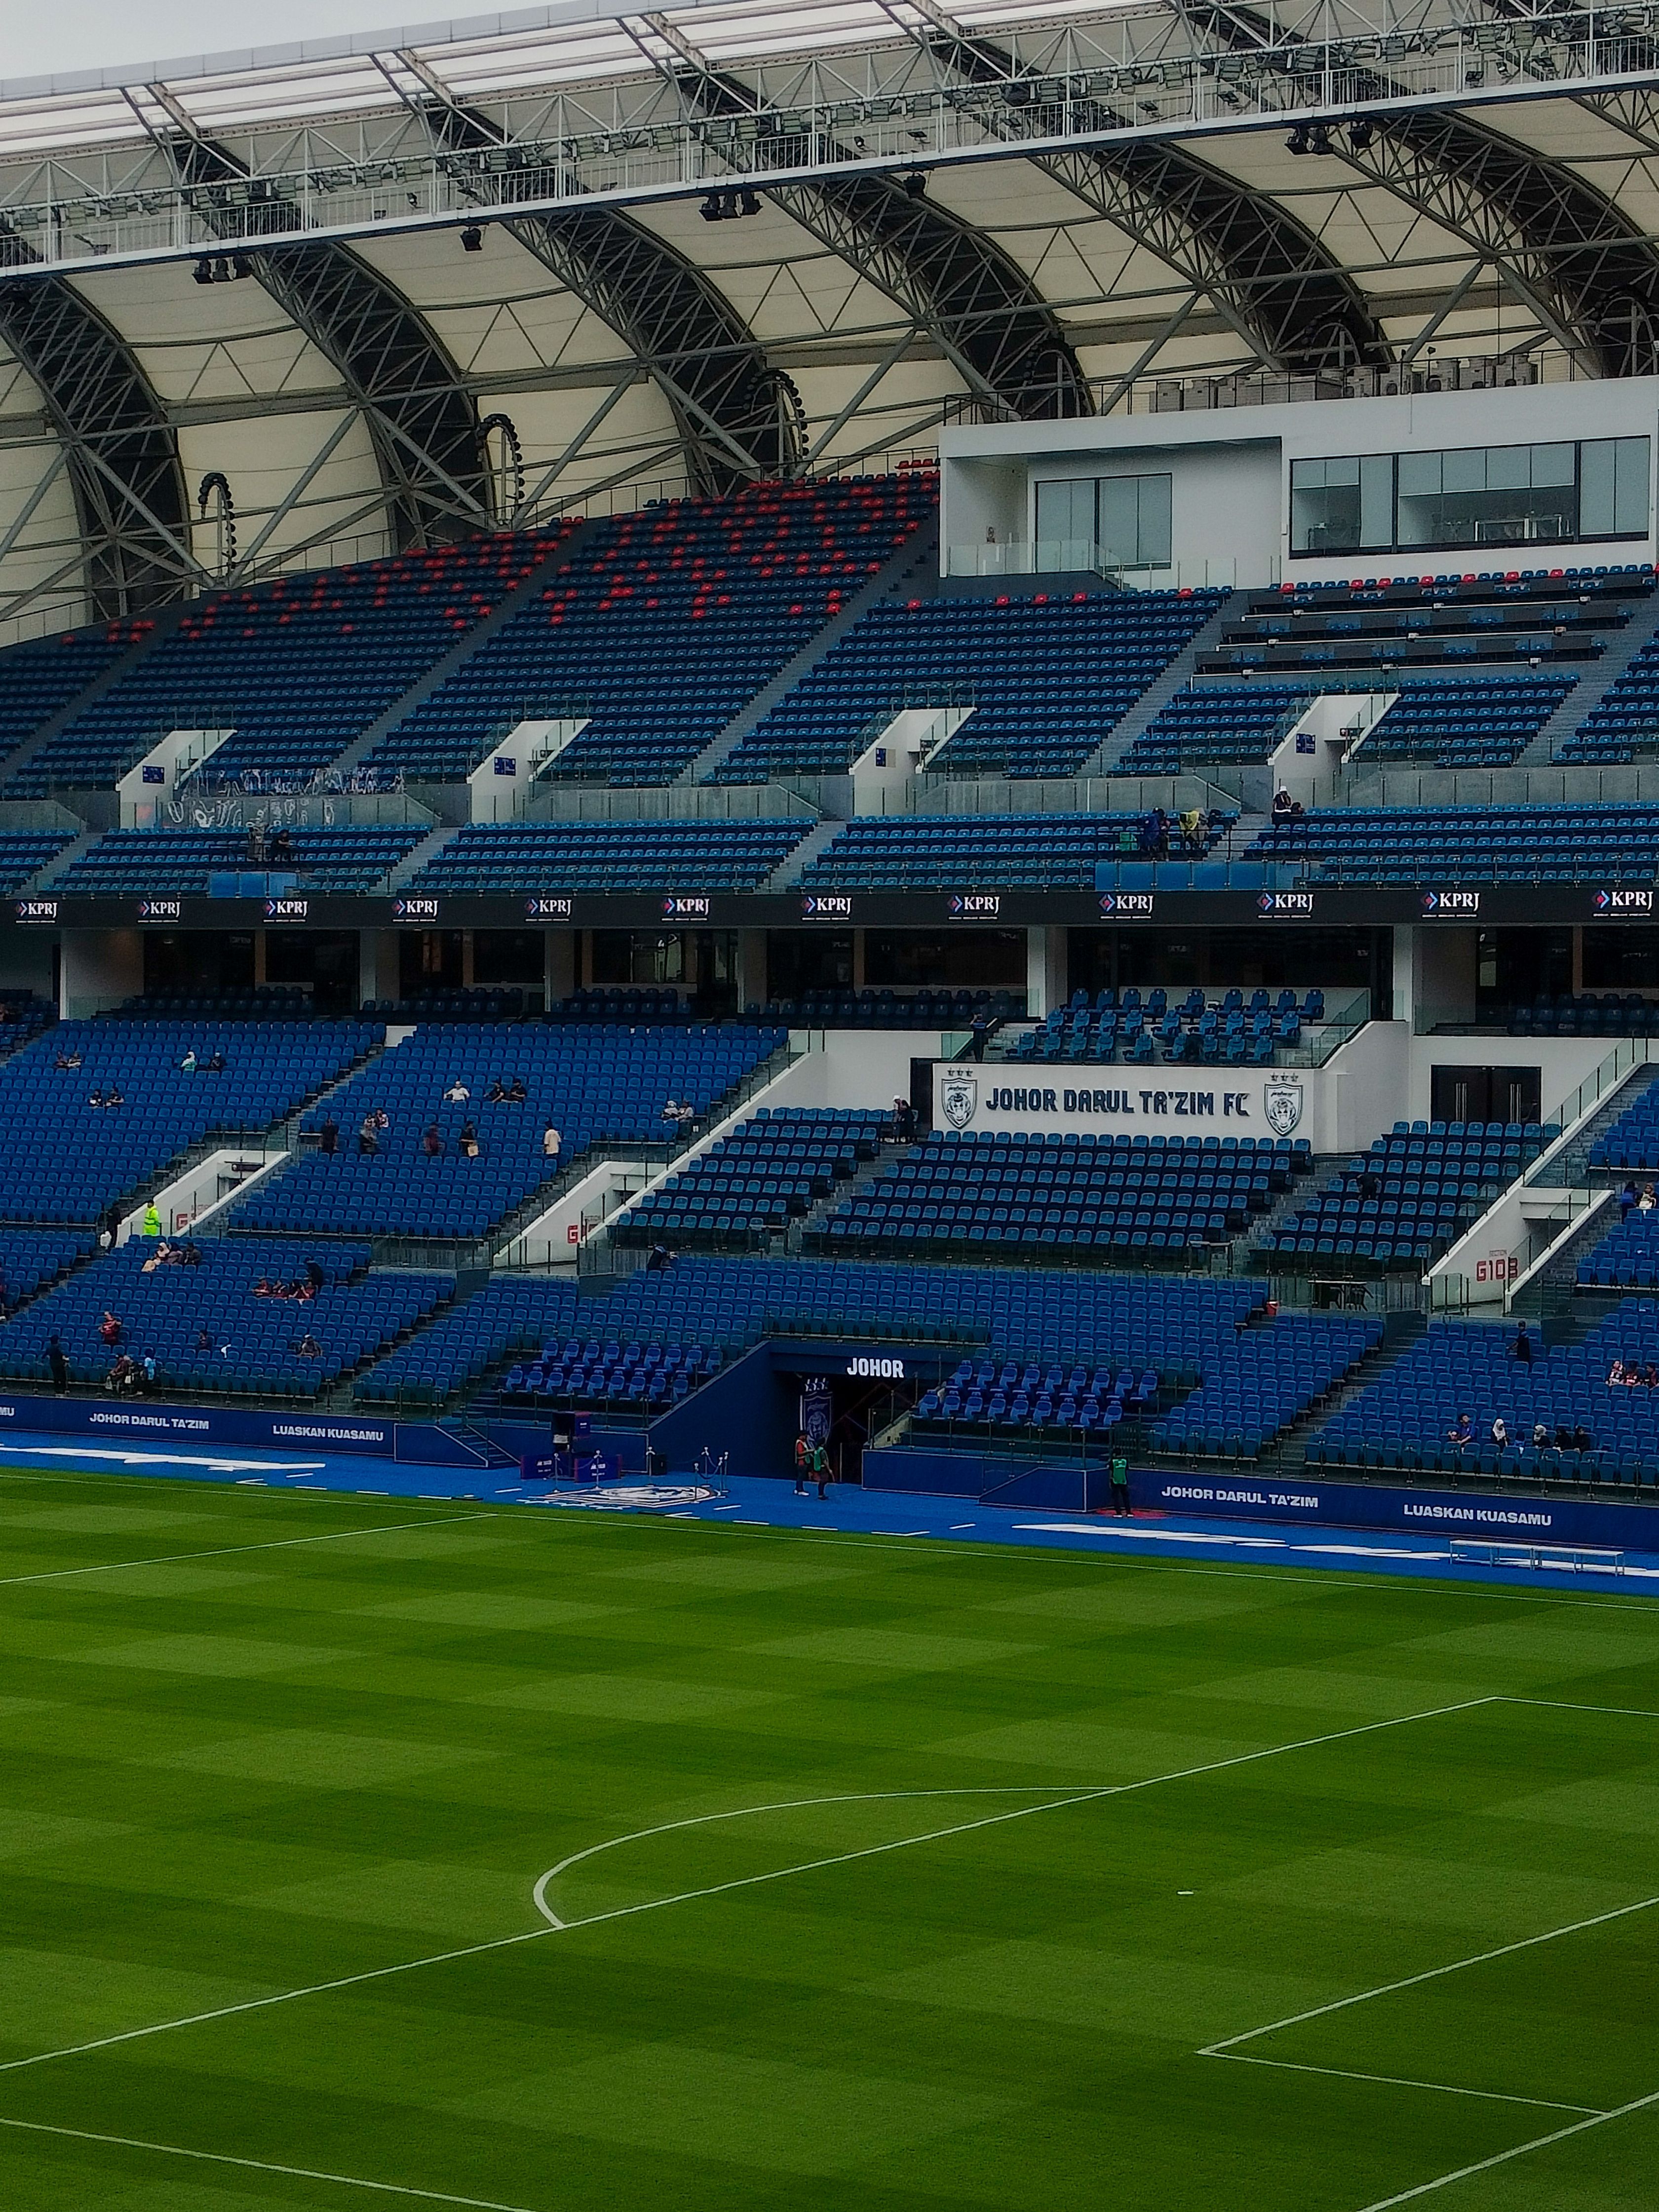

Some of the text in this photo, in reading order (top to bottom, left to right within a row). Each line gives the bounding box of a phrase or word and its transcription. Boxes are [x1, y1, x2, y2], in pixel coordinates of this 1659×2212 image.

[151, 902, 180, 917] KPRJ
[277, 901, 308, 916] KPRJ
[406, 900, 438, 916] KPRJ
[540, 900, 572, 915] KPRJ
[676, 899, 710, 915] KPRJ
[816, 898, 851, 914] KPRJ
[964, 896, 1000, 914] KPRJ
[1117, 895, 1154, 913] KPRJ
[1275, 894, 1313, 912] KPRJ
[1439, 893, 1480, 911] KPRJ
[1612, 891, 1654, 910] KPRJ
[28, 902, 58, 918] KPRJ
[986, 1088, 1250, 1117] JOHOR DARUL TA'ZIM FC
[847, 1358, 904, 1378] JOHOR
[89, 1412, 209, 1430] JOHOR DARUL TA'ZIM
[272, 1425, 384, 1442] LUASKAN KUASAMU
[1161, 1486, 1318, 1508] JOHOR DARUL TA'ZIM
[1403, 1504, 1552, 1526] LUASKAN KUASAMU
